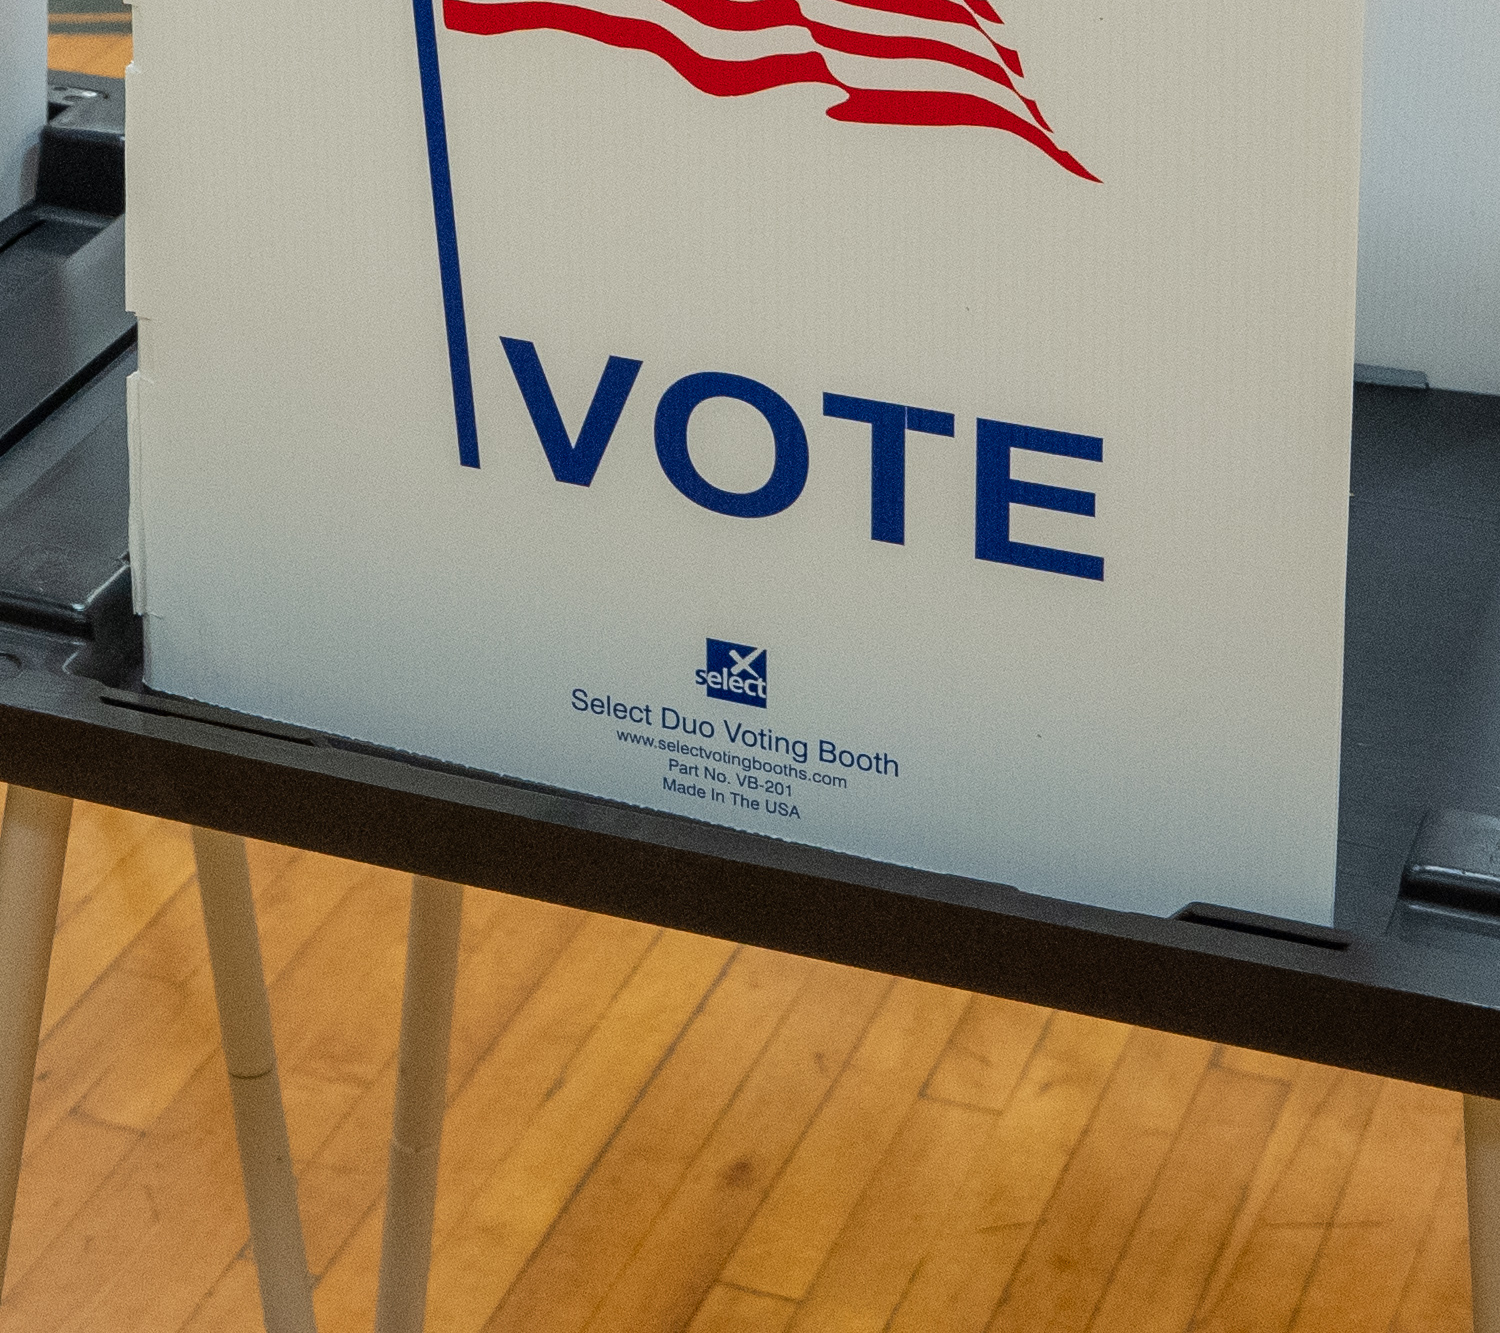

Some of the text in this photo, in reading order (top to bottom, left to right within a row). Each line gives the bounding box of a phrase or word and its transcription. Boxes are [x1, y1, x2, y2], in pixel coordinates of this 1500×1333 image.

[498, 335, 1106, 582] VOTE
[694, 666, 767, 699] select
[570, 687, 900, 778] Select Duo Voting Booth
[616, 730, 848, 789] www.selectvotingbooths.com
[668, 758, 793, 797] Part No. VB-201
[662, 776, 801, 820] Made In The USA
